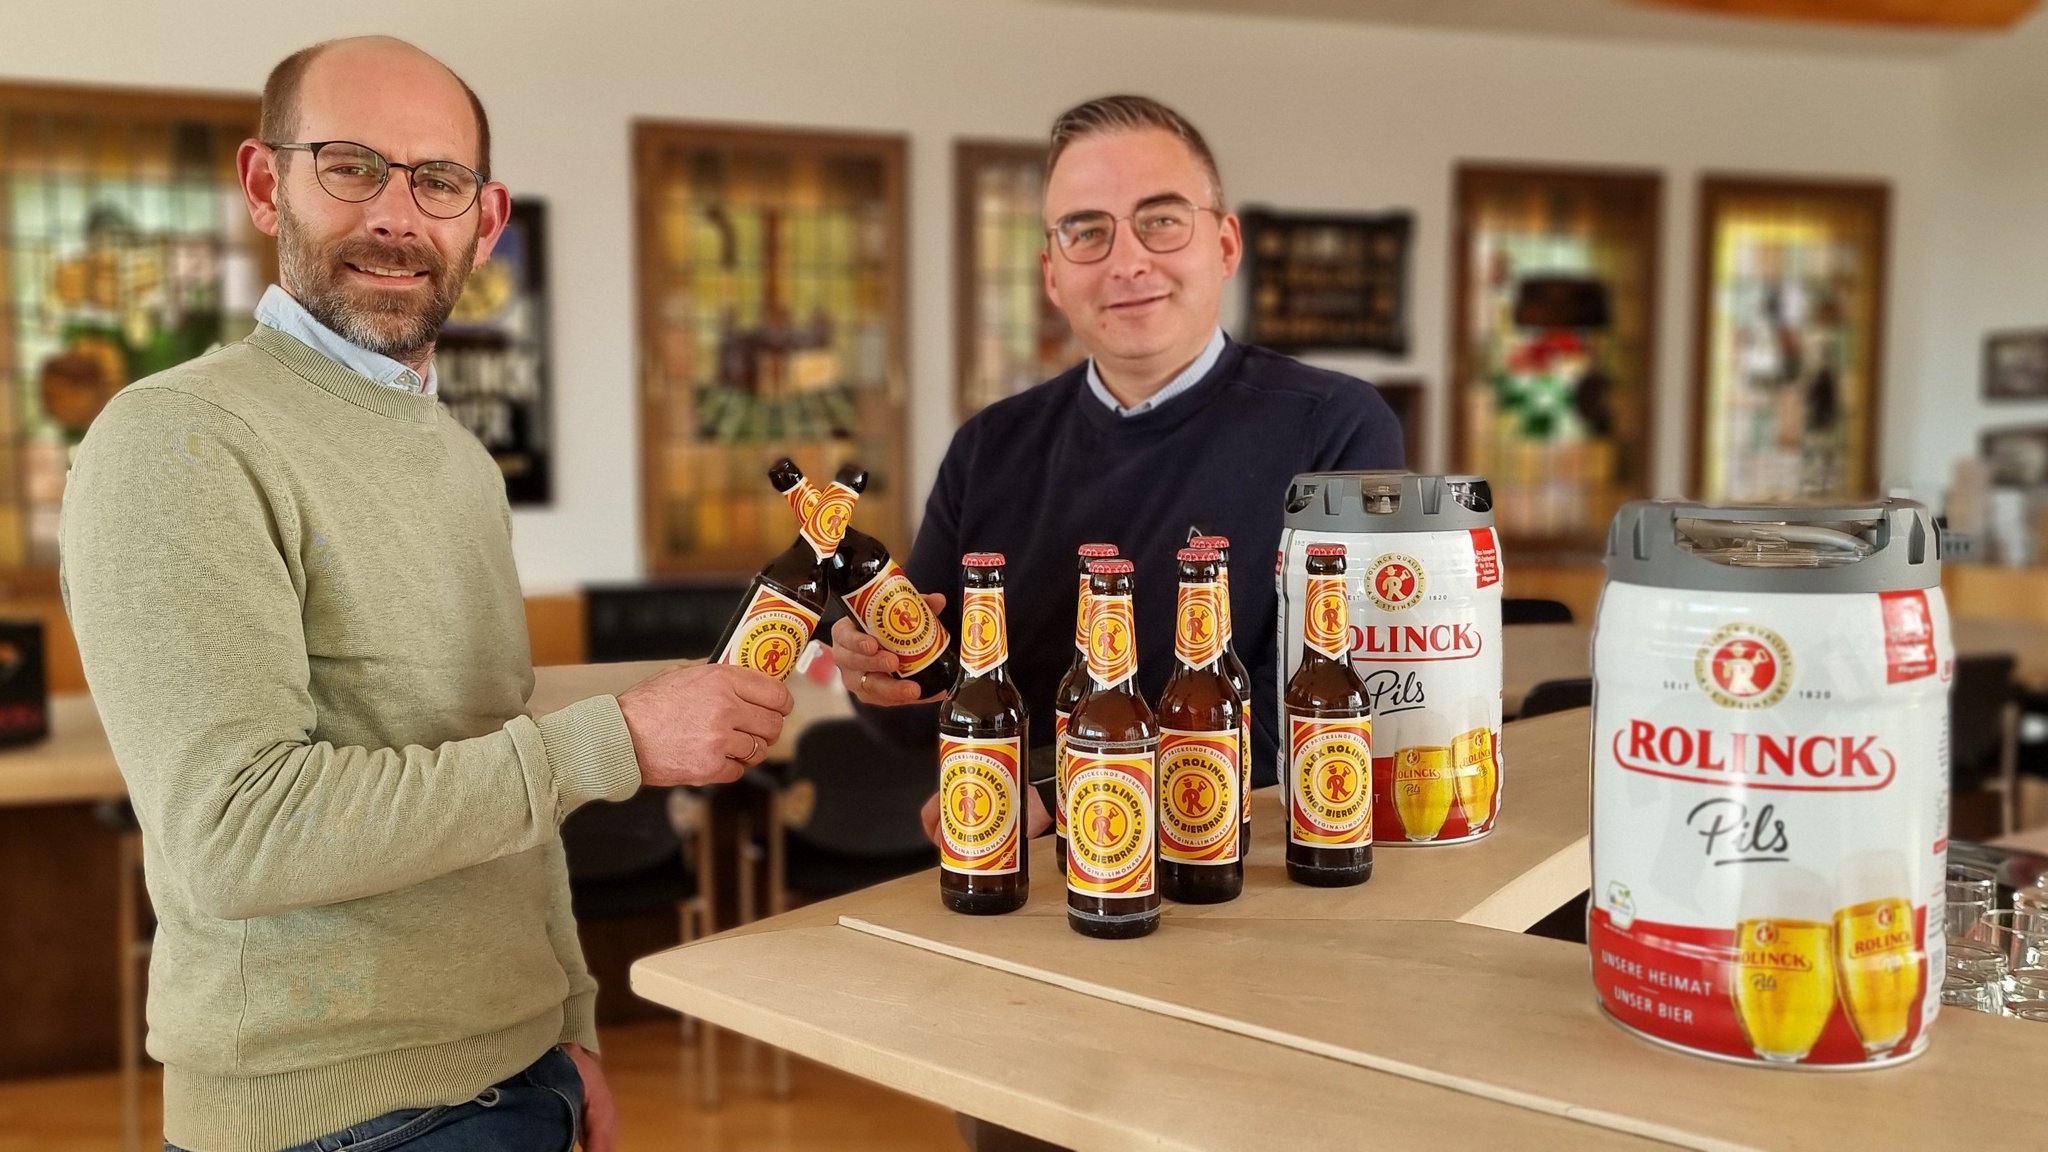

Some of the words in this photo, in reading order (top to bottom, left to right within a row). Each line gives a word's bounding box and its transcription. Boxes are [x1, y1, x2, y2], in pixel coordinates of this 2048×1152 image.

[750, 623, 777, 641] ALEX
[875, 603, 886, 629] ALEX
[886, 633, 911, 646] TANGO
[1349, 622, 1474, 653] OLINCK
[1365, 669, 1425, 712] Pils
[1663, 680, 1690, 691] SEIT
[1798, 690, 1832, 699] 1820
[1303, 748, 1326, 777] ALEX
[1326, 744, 1368, 775] ROLINCK
[1629, 718, 1881, 778] ROLINCK
[942, 768, 959, 797] ALEX
[959, 765, 1007, 800] ROLINCK
[986, 758, 1010, 779] BIERMIX
[1162, 760, 1181, 788] ALEX
[1181, 758, 1229, 791] ROLINCK
[1072, 786, 1091, 815] ALEX
[1092, 783, 1142, 819] ROLINCK
[1162, 797, 1180, 827] TANGO
[1180, 800, 1228, 833] BIERBRAUSE
[1303, 784, 1325, 813] TANGO
[1325, 784, 1368, 819] BIERBRAUSE
[943, 804, 957, 836] TANGO
[957, 809, 1006, 843] BIERBRAUSE
[1686, 797, 1790, 858] Pils
[1073, 825, 1090, 857] TANGO
[1091, 828, 1142, 865] BIERBRAUSE
[1601, 949, 1644, 980] UNSERE
[1648, 968, 1712, 997] HEIMAT
[1614, 985, 1653, 1014] UNSER
[1658, 1002, 1694, 1025] BIER
